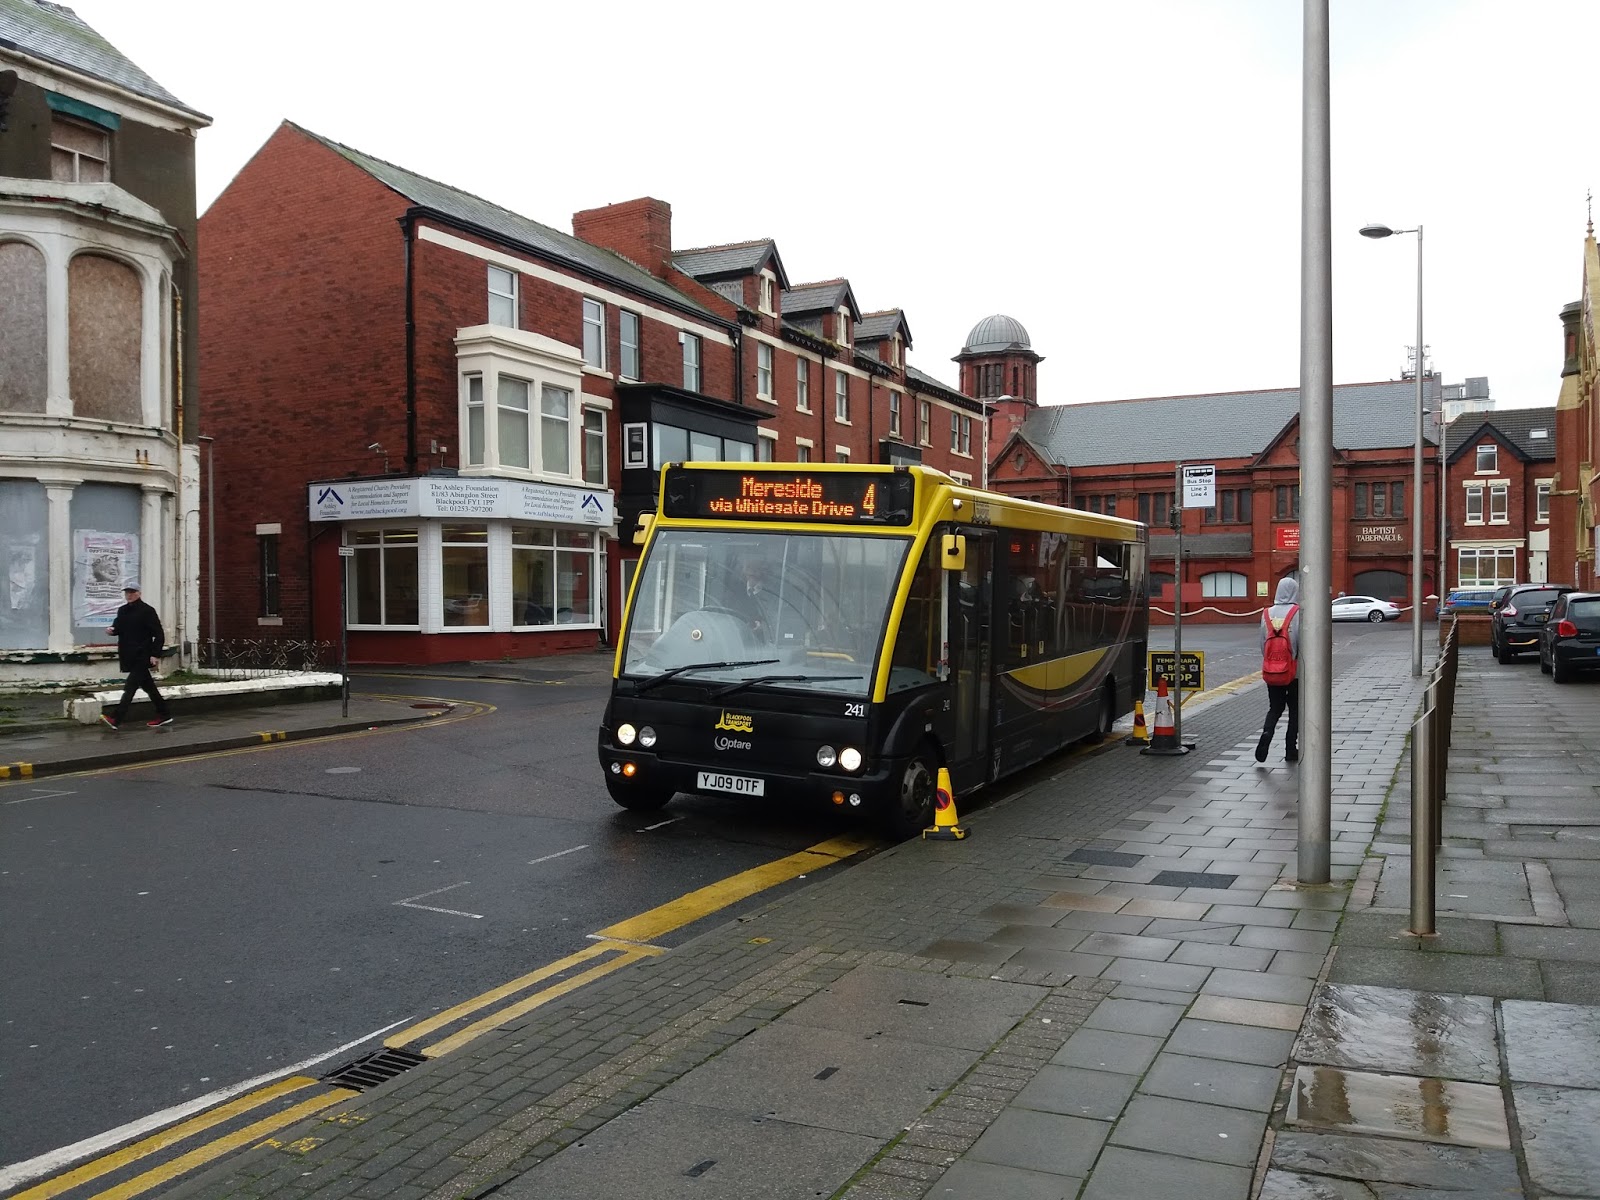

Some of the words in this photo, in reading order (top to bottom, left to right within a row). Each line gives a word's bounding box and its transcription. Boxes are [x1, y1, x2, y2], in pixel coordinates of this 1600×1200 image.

[443, 484, 464, 492] Ashley
[742, 477, 823, 499] Mereside
[449, 491, 479, 499] Abingdon
[862, 483, 876, 515] 4
[435, 498, 466, 506] Blackpool
[709, 498, 733, 513] via
[811, 500, 855, 517] Drive
[1362, 526, 1397, 535] BAPTIST
[844, 703, 865, 718] 241
[725, 712, 752, 722] BLACKPOOL
[725, 719, 752, 727] TRANSPORT
[719, 737, 752, 750] Optare
[702, 774, 733, 791] YJ09
[735, 776, 760, 793] OTF
